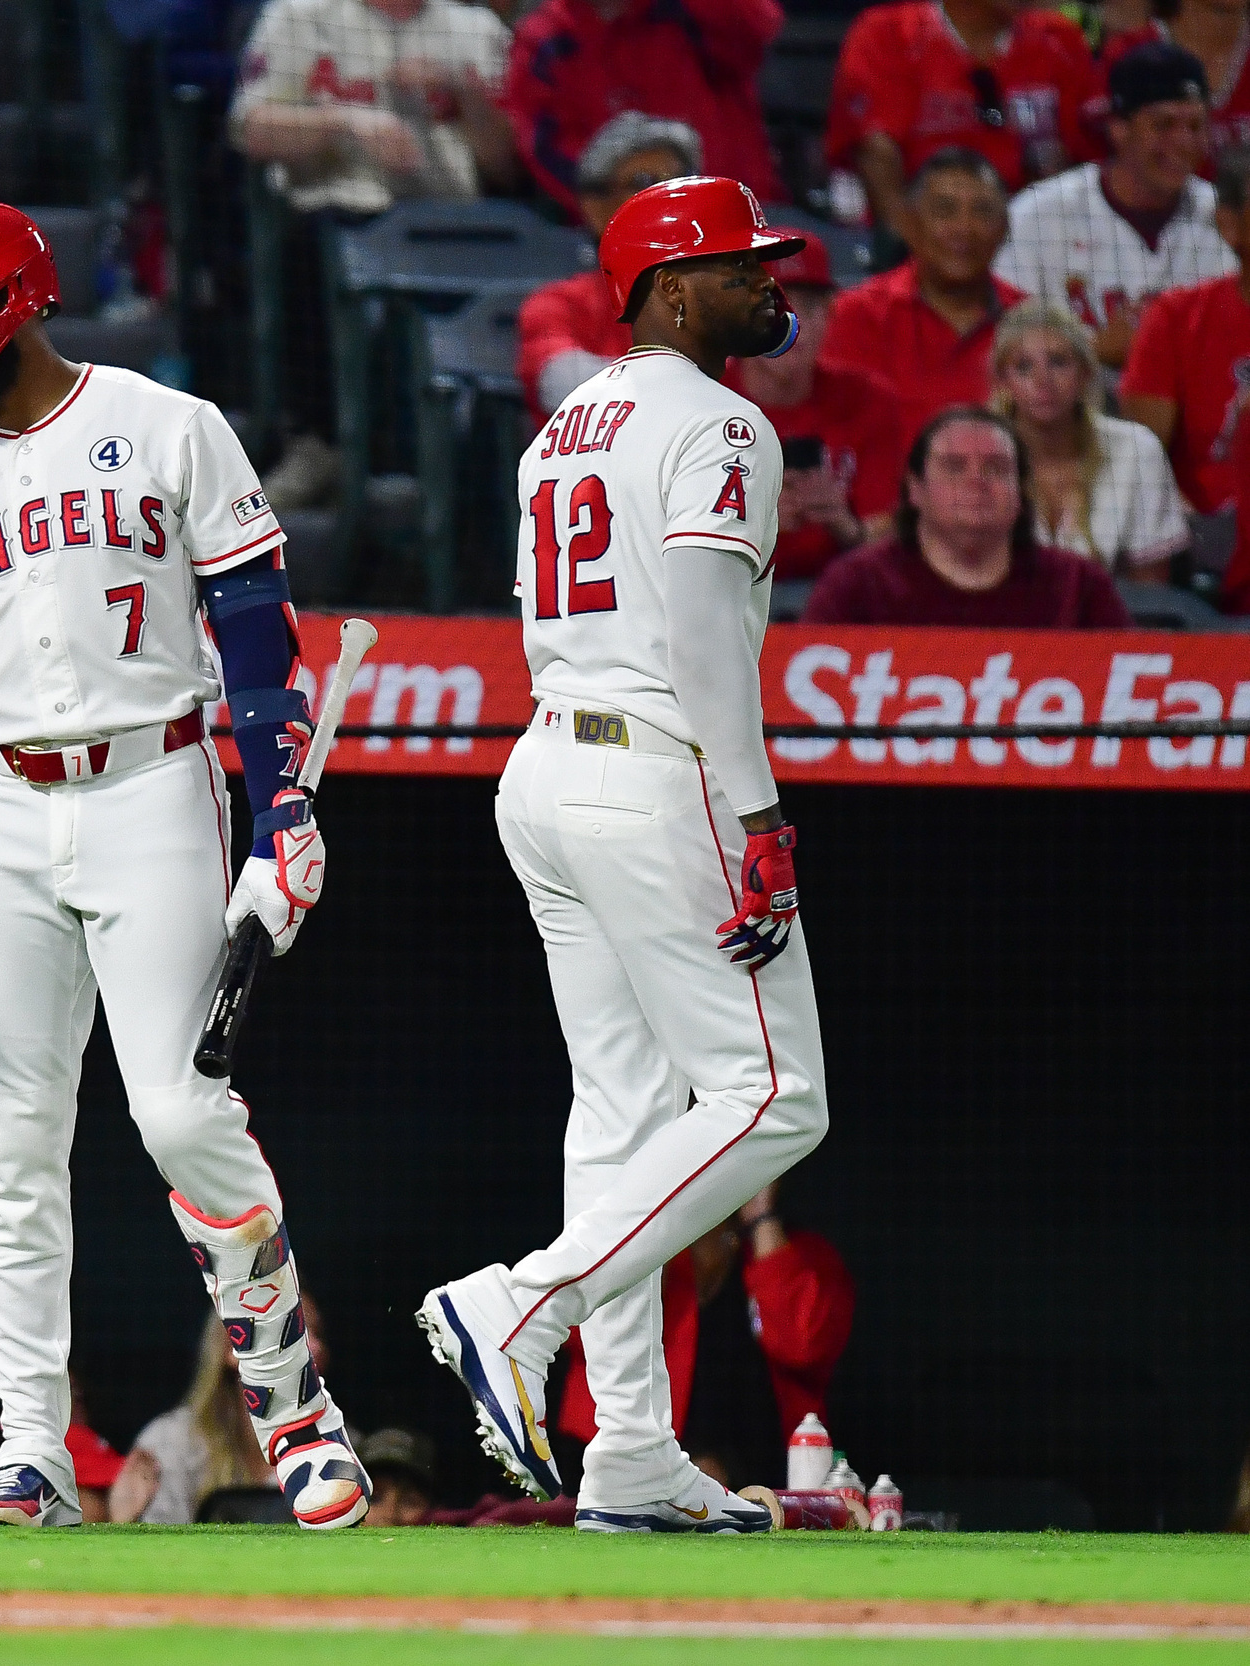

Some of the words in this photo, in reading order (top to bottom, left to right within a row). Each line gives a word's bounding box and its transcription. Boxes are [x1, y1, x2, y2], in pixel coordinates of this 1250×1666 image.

[98, 441, 120, 467] 4
[541, 401, 635, 460] SOLER
[727, 423, 752, 441] GA
[710, 455, 750, 521] A
[530, 474, 617, 620] 12
[105, 581, 146, 657] 7
[71, 756, 82, 776] 7
